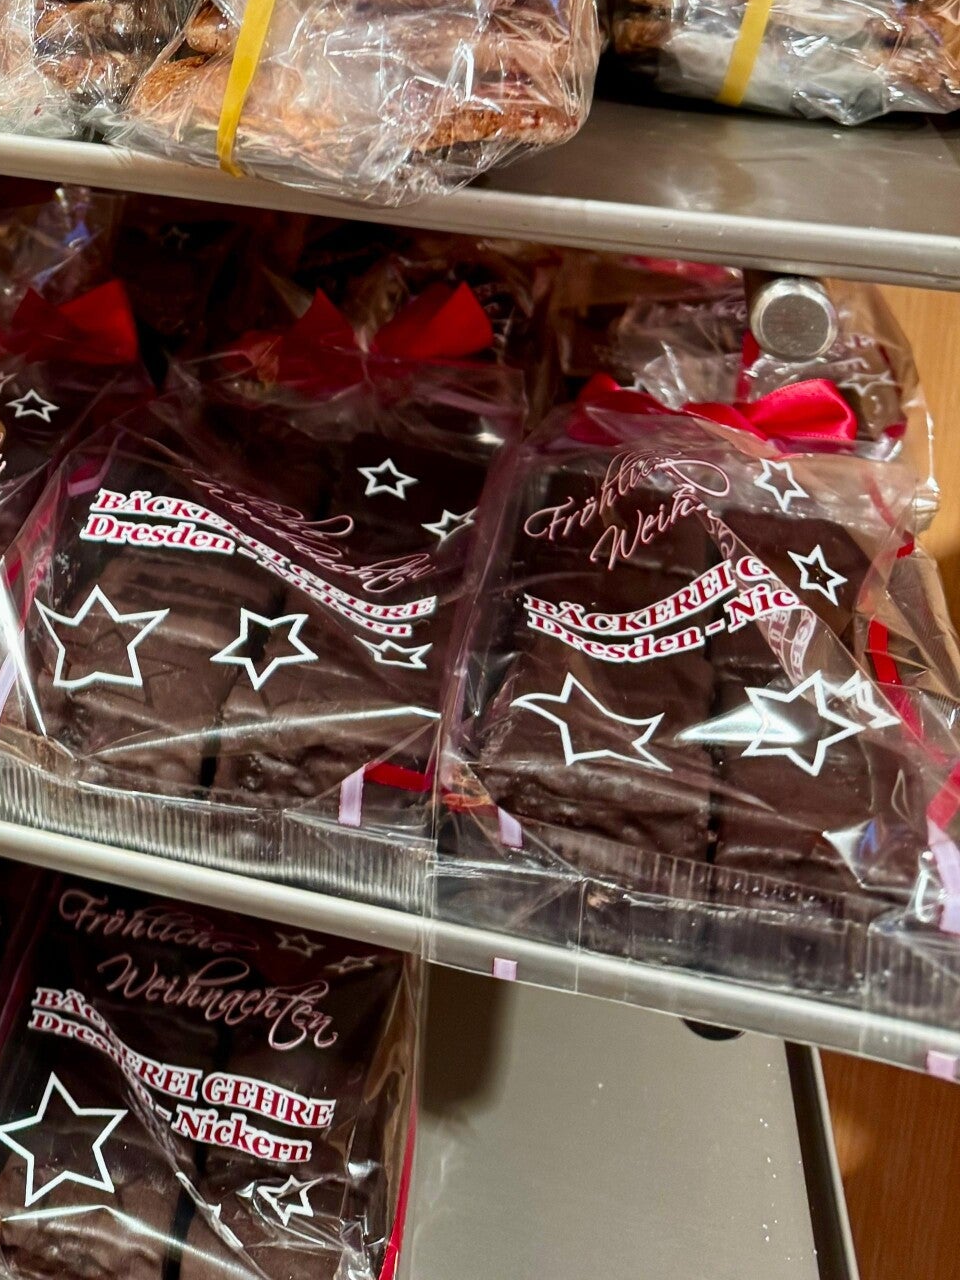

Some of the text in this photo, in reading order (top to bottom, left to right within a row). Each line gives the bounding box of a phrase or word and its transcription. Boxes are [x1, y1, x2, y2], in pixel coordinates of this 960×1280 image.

[79, 513, 237, 556] Dresden
[89, 487, 293, 569] BÄCKEREI
[523, 559, 739, 634] BÄCKEREI
[526, 609, 704, 664] Dresden
[96, 952, 339, 1051] Weihnachten
[200, 1071, 338, 1129] GEHRE
[170, 1103, 313, 1163] Nickern
